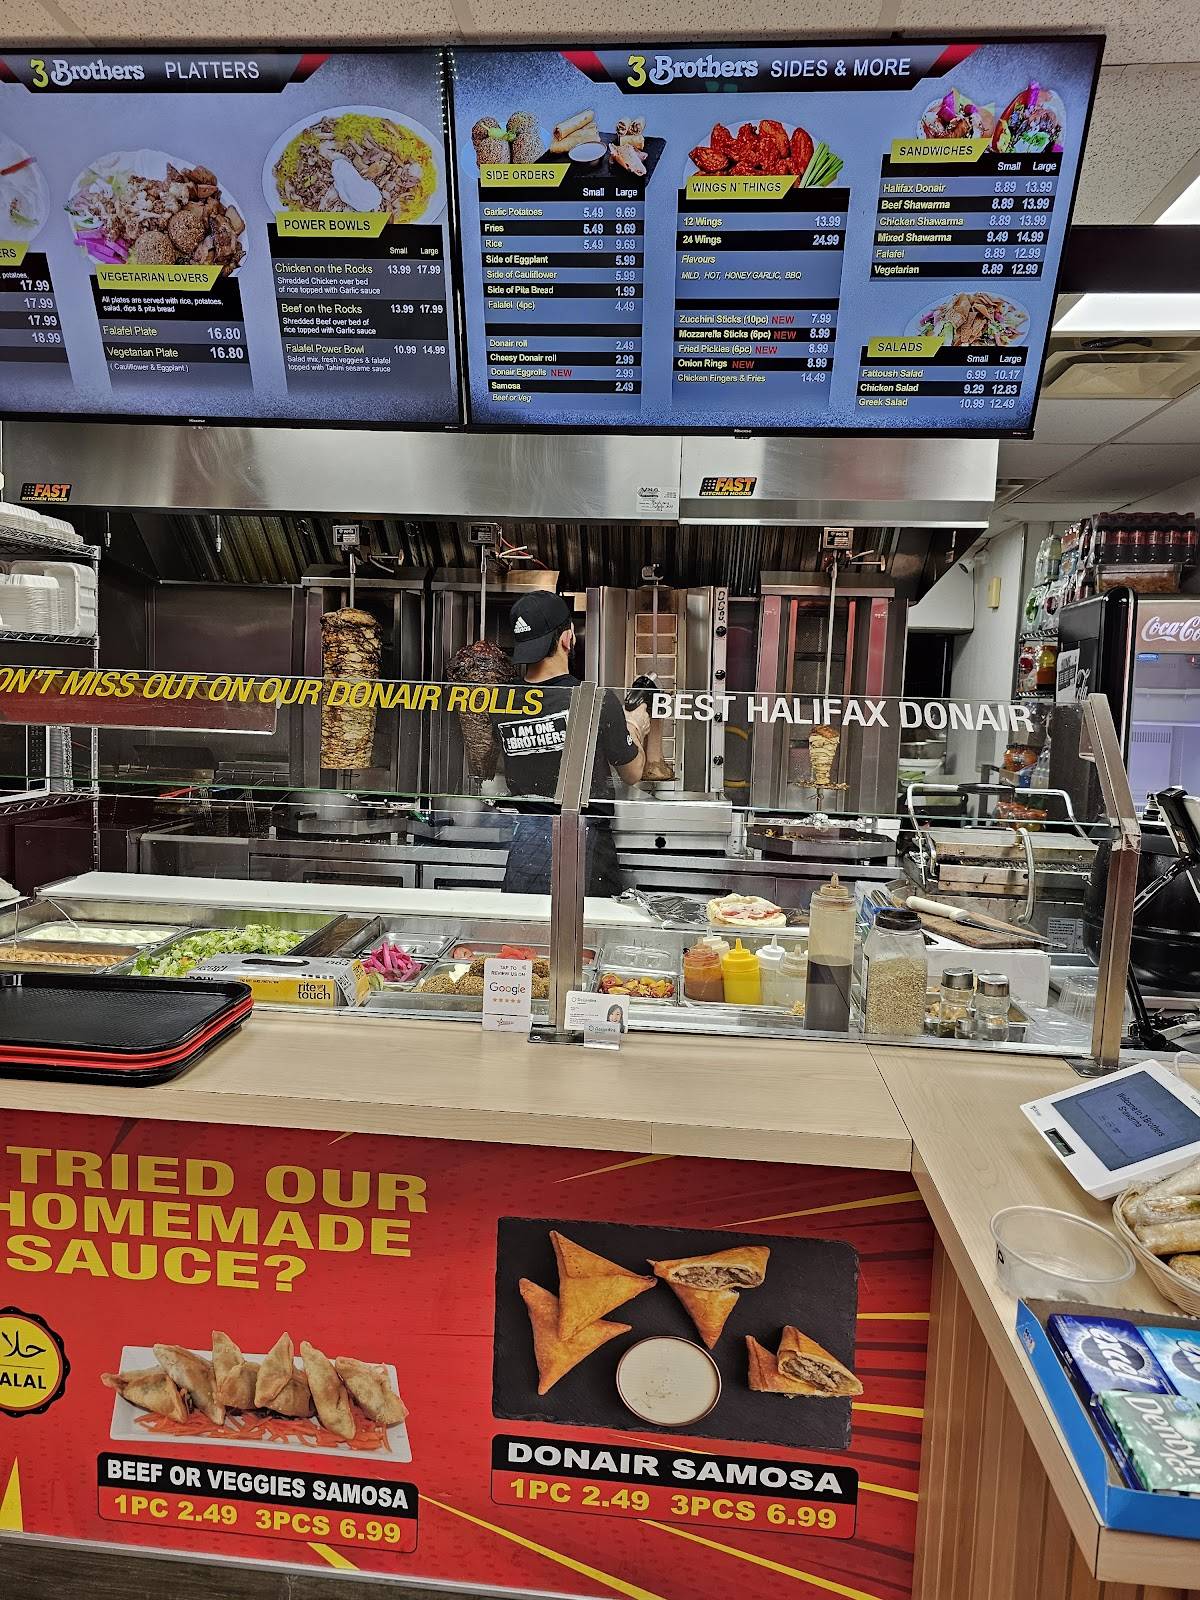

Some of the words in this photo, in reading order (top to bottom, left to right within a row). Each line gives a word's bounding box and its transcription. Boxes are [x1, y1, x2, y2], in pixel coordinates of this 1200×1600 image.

[30, 59, 49, 88] 3
[50, 59, 145, 86] Brothers
[164, 61, 260, 80] PLATTERS
[627, 55, 647, 88] 3
[649, 55, 760, 85] Brothers
[770, 60, 828, 78] SIDES
[834, 60, 847, 76] &
[853, 58, 911, 77] MORE
[899, 145, 973, 156] SANDWICHES
[486, 170, 509, 180] SIDE
[512, 170, 555, 180] ORDERS
[692, 182, 727, 192] WINGS
[743, 182, 782, 192] THINGS
[883, 184, 914, 192] Halifax
[915, 183, 947, 193] Donair
[994, 181, 1016, 193] 8.89
[1025, 181, 1053, 193] 13.99
[582, 188, 605, 197] Small
[615, 188, 638, 198] Large
[881, 200, 903, 209] Beef
[903, 200, 950, 209] Shawarma
[992, 198, 1014, 210] 8.89
[1022, 198, 1050, 210] 13.99
[483, 208, 507, 217] Garlic
[508, 208, 543, 216] Potatoes
[583, 207, 604, 218] 5.49
[615, 207, 636, 218] 9.69
[284, 220, 327, 230] POWER
[330, 220, 371, 231] BOWLS
[683, 217, 694, 226] 12
[695, 217, 723, 227] Wings
[814, 216, 841, 226] 13.99
[484, 224, 504, 232] Fries
[583, 223, 604, 234] 5.49
[615, 223, 636, 234] 9.69
[682, 235, 693, 244] 24
[694, 235, 722, 245] Wings
[812, 234, 839, 246] 24.99
[877, 233, 904, 242] Mixed
[905, 233, 952, 242] Shawarma
[986, 231, 1008, 243] 9.49
[1016, 231, 1044, 243] 14.99
[485, 240, 503, 248] Rice
[583, 239, 604, 250] 5.49
[615, 239, 636, 250] 9.69
[389, 247, 408, 255] Small
[420, 248, 439, 256] Large
[275, 263, 312, 273] Chicken
[314, 265, 322, 273] on
[324, 264, 343, 273] the
[344, 264, 373, 274] Rocks
[387, 265, 411, 274] 13.99
[416, 265, 441, 274] 17.99
[100, 272, 165, 282] VEGETARIAN
[168, 273, 209, 283] LOVERS
[20, 280, 50, 291] 17.99
[24, 298, 54, 309] 17.99
[281, 304, 303, 314] Beef
[304, 306, 316, 314] on
[317, 305, 333, 314] the
[334, 304, 363, 314] Rocks
[390, 304, 414, 314] 13.99
[419, 304, 443, 314] 17.99
[488, 301, 513, 309] Falafel
[516, 301, 536, 311] (4pc)
[615, 301, 635, 311] 4.49
[28, 315, 57, 326] 17.99
[32, 332, 61, 343] 18.99
[102, 326, 133, 335] Falafel
[134, 327, 158, 336] Plate
[207, 327, 241, 340] 16.80
[286, 344, 314, 354] Falafel
[315, 345, 342, 354] Power
[343, 345, 365, 354] Bowl
[393, 345, 417, 354] 10.99
[422, 345, 446, 355] 14.99
[615, 341, 634, 351] 2.49
[877, 342, 922, 352] SALADS
[107, 347, 153, 358] Vegetarian
[155, 348, 179, 358] Plate
[209, 347, 244, 359] 16.80
[677, 359, 703, 367] Onion
[704, 359, 728, 369] Rings
[732, 360, 755, 369] NEW
[807, 358, 827, 368] 8.99
[860, 384, 894, 392] Chicken
[963, 384, 985, 394] 9.29
[991, 384, 1018, 394] 12.83
[714, 478, 755, 491] FAST
[34, 484, 70, 497] FAST
[60, 670, 137, 698] MISS
[143, 674, 207, 700] OUT
[208, 676, 255, 702] ON
[260, 679, 322, 705] OUR
[326, 680, 442, 711] DONAIR
[447, 686, 544, 716] ROLLS
[651, 691, 736, 722] BEST
[747, 696, 890, 728] HALIFAX
[899, 701, 1035, 733] DONAIR
[512, 728, 516, 737] I
[518, 725, 533, 737] AM
[535, 721, 555, 734] ONE
[298, 982, 317, 992] rite
[489, 982, 525, 995] Google
[298, 990, 331, 1001] touch
[6, 1145, 235, 1198] TRIED
[264, 1165, 429, 1214] OUR
[6, 1234, 307, 1293] SAUCE?
[1088, 1327, 1159, 1387] excel
[508, 1442, 660, 1477] DONAIR
[671, 1458, 843, 1494] SAMOSA
[107, 1459, 163, 1483] BEEF
[169, 1465, 201, 1488] OR
[207, 1469, 306, 1498] VEGGIES
[312, 1480, 409, 1510] SAMOSA
[510, 1478, 571, 1503] 1PC
[581, 1485, 651, 1511] 2.49
[670, 1494, 756, 1521] 3PCS
[766, 1503, 837, 1530] 6.99
[114, 1494, 168, 1518] 1PC
[177, 1500, 238, 1525] 2.49
[255, 1509, 330, 1536] 3PCS
[339, 1518, 401, 1544] 6.99
